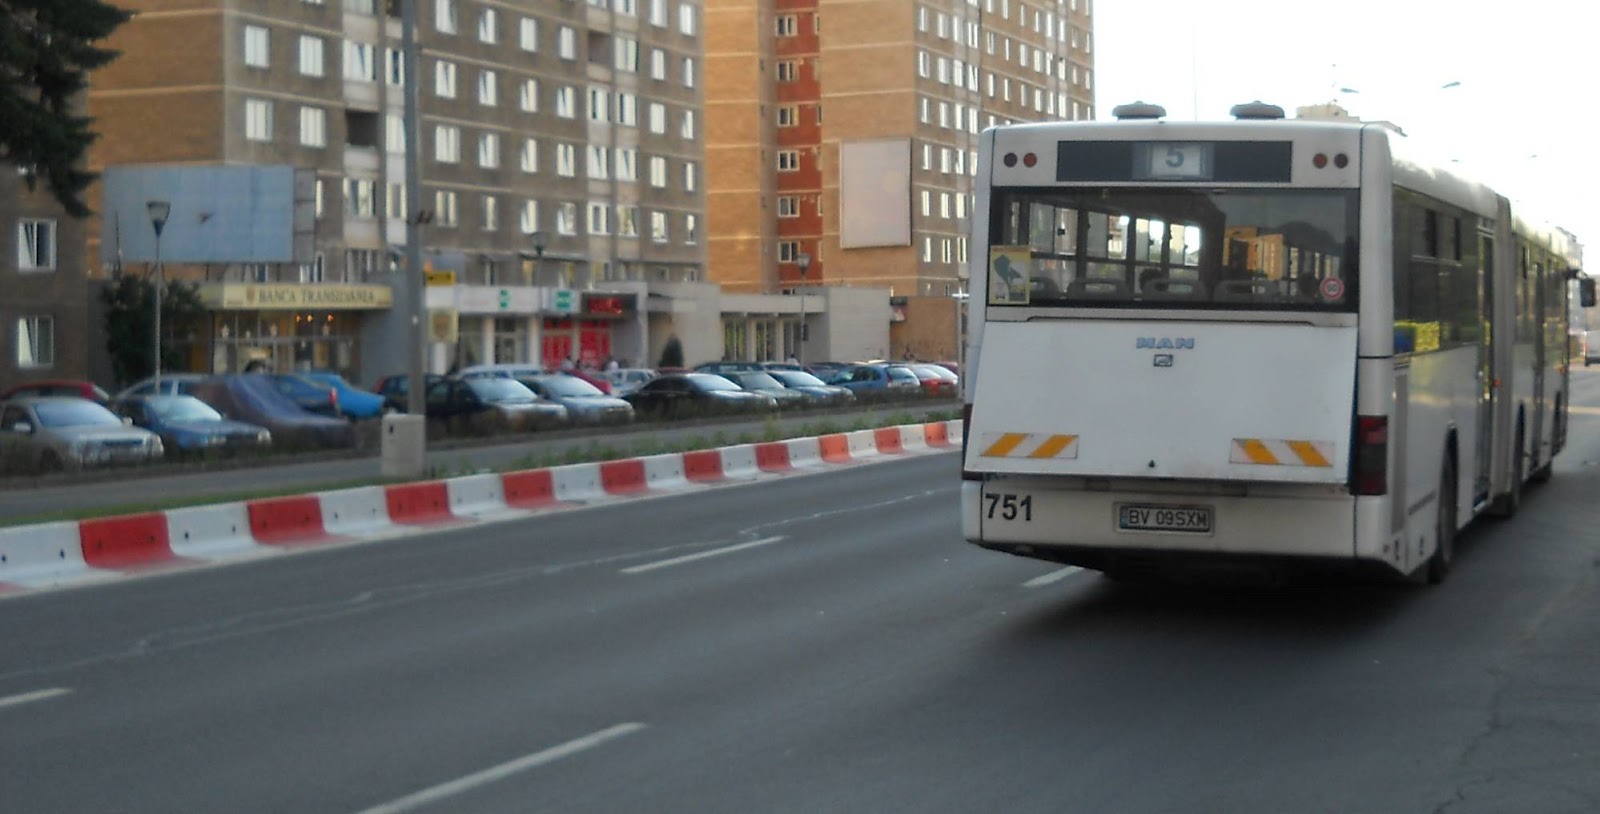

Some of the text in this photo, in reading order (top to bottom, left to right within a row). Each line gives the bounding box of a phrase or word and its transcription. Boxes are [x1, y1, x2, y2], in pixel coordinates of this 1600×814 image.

[1165, 145, 1185, 168] 5
[258, 287, 295, 302] BANCA
[1136, 337, 1195, 349] MAN
[985, 493, 1032, 521] 751
[1129, 509, 1150, 525] BV
